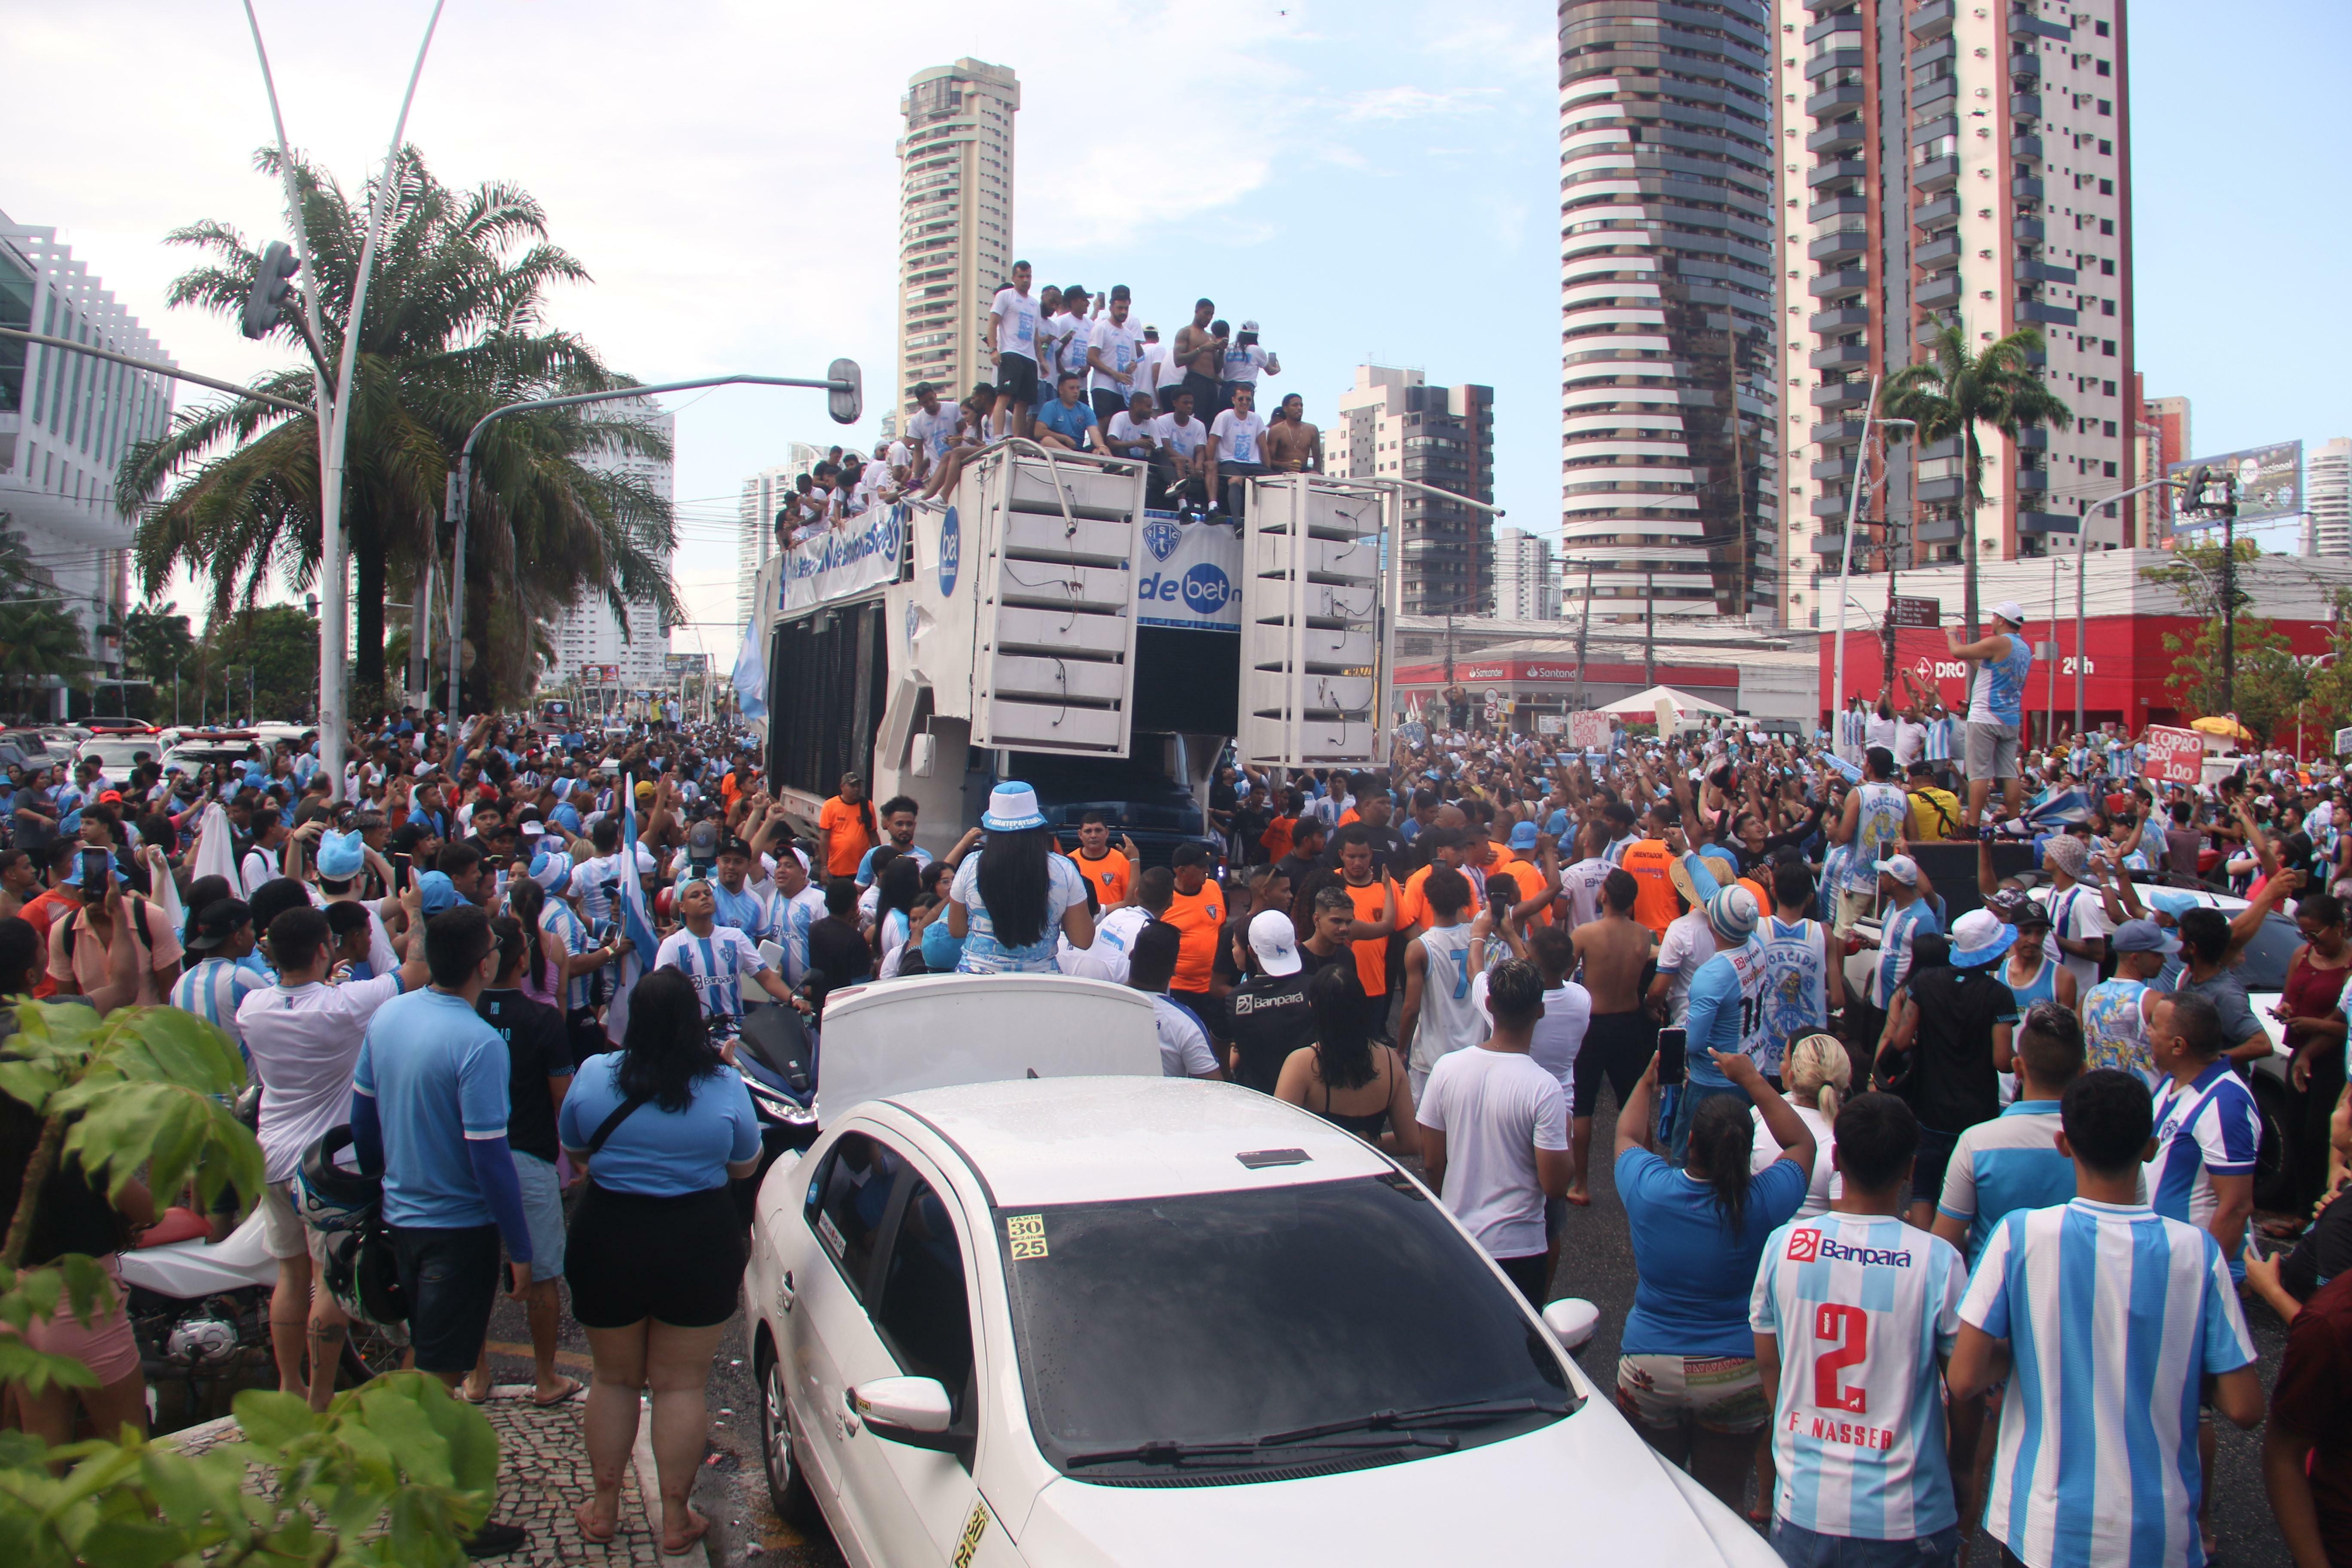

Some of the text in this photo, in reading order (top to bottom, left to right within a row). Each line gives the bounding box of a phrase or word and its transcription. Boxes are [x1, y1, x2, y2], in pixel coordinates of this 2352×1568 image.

[943, 527, 957, 561] bet
[1476, 668, 1504, 677] Santander
[1539, 668, 1584, 678] Santand
[2151, 730, 2201, 753] COPÃO
[1633, 851, 1663, 859] ORIENTADOR
[1767, 950, 1818, 973] ORCIDA
[1450, 948, 1469, 999] 7
[1254, 991, 1304, 1008] Banpará
[1011, 1221, 1041, 1235] 30
[1014, 1240, 1045, 1258] 25
[1820, 1237, 1911, 1268] Banpará
[1815, 1302, 1868, 1414] 2
[1812, 1417, 1893, 1450] NASSER
[977, 1501, 990, 1522] TAXIS
[967, 1510, 985, 1543] 30
[954, 1544, 971, 1568] 25
